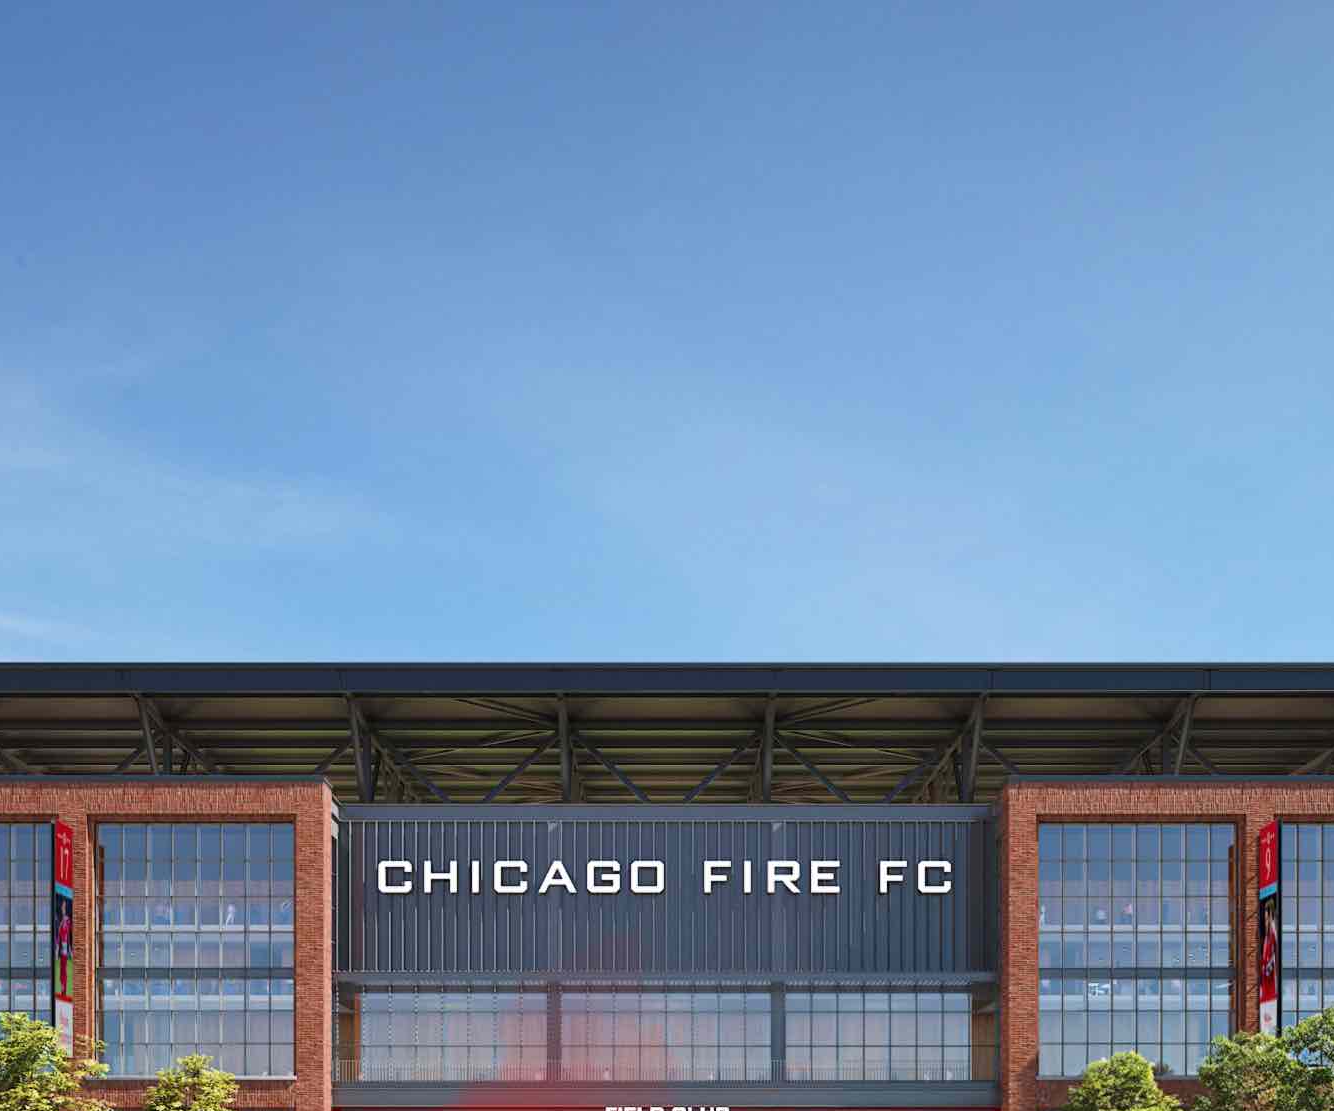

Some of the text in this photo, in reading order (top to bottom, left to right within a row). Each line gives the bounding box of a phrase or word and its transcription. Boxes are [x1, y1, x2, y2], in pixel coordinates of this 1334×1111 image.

[377, 860, 953, 894] CHICAGO FIRE FC
